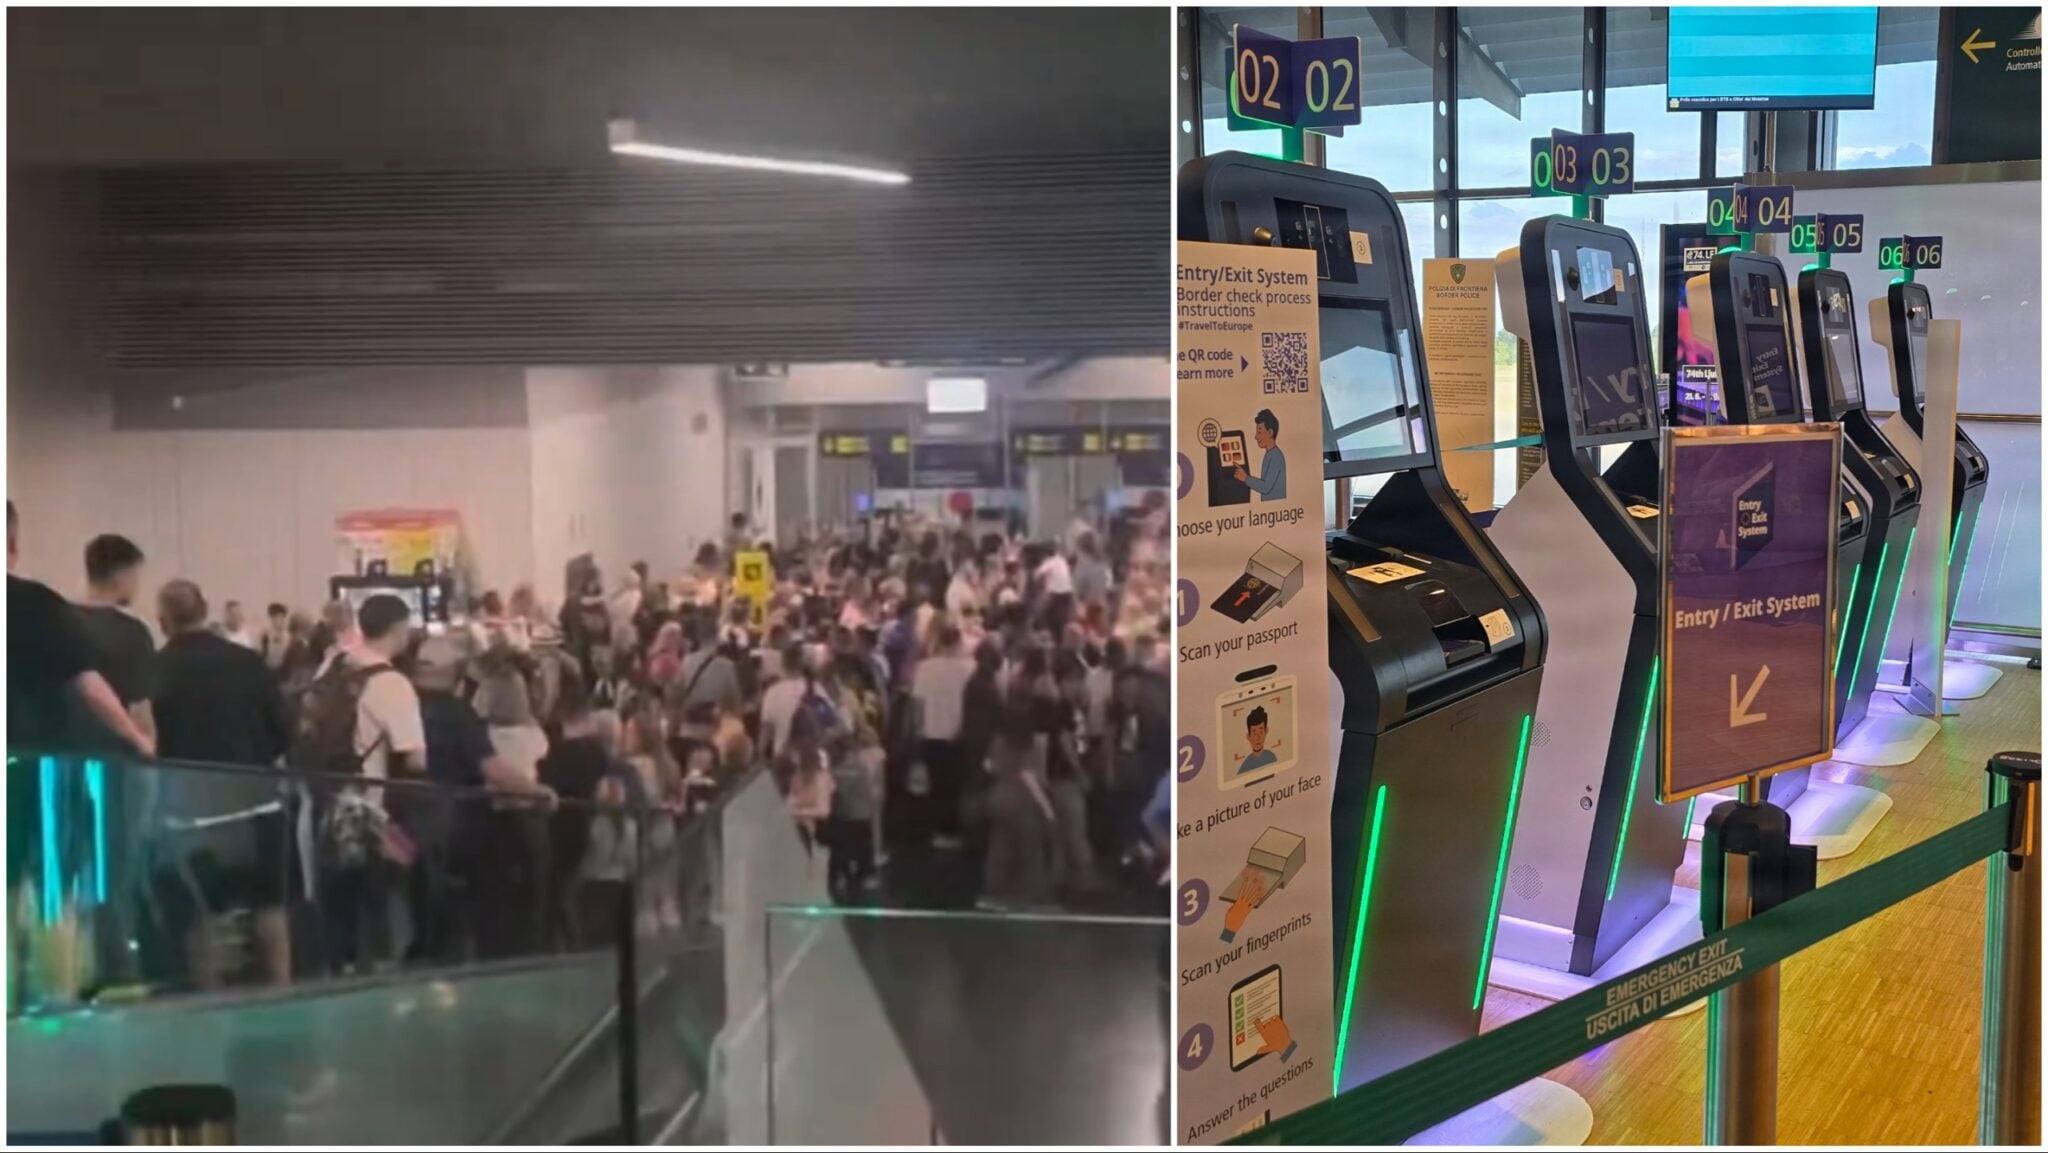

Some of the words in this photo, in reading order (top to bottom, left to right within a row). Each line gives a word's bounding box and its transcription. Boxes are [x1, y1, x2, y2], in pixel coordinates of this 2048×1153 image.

[2006, 45, 2042, 58] Controll
[1240, 48, 1281, 110] 02
[1305, 58, 1355, 113] 02
[1534, 151, 1552, 188] 0
[1555, 143, 1577, 183] 03
[1591, 147, 1630, 185] 03
[1735, 194, 1748, 225] 04
[1758, 196, 1792, 226] 04
[1791, 224, 1817, 248] 05
[1833, 223, 1861, 247] 05
[1880, 245, 1904, 266] 06
[1916, 244, 1941, 265] 06
[1177, 264, 1254, 286] Entry/Exit
[1256, 268, 1308, 288] System
[1177, 286, 1223, 302] Border
[1226, 288, 1263, 304] check
[1265, 293, 1312, 307] process
[1177, 302, 1256, 318] instructions
[1178, 321, 1254, 333] #TravelToEurope
[1188, 348, 1205, 363] QR
[1207, 348, 1233, 361] code
[1205, 368, 1234, 379] more
[1739, 500, 1762, 513] Entry
[1751, 512, 1768, 524] Exit
[1216, 516, 1246, 536] your
[1248, 507, 1305, 529] language
[1738, 526, 1768, 539] System
[1675, 608, 1720, 629] Entry
[1733, 598, 1764, 620] Exit
[1766, 593, 1821, 618] System
[1179, 644, 1212, 663] Scan
[1214, 636, 1244, 659] your
[1247, 621, 1299, 651] passport
[1178, 745, 1195, 774] 2
[1195, 819, 1204, 832] a
[1207, 800, 1251, 832] picture
[1253, 790, 1267, 810] of
[1268, 783, 1295, 808] your
[1298, 774, 1322, 793] face
[1183, 888, 1199, 917] 3
[1181, 961, 1212, 987] Scan
[1215, 945, 1244, 974] your
[1246, 912, 1312, 954] fingerprints
[1606, 952, 1698, 1007] EMERGENCY
[1698, 938, 1729, 965] EXIT
[1586, 1000, 1641, 1041] USCITA
[1642, 992, 1658, 1015] DI
[1660, 954, 1744, 1007] EMERGENZA
[1186, 1032, 1204, 1059] 4
[1187, 1104, 1235, 1144] Answer
[1237, 1091, 1258, 1113] the
[1260, 1056, 1315, 1101] questions
